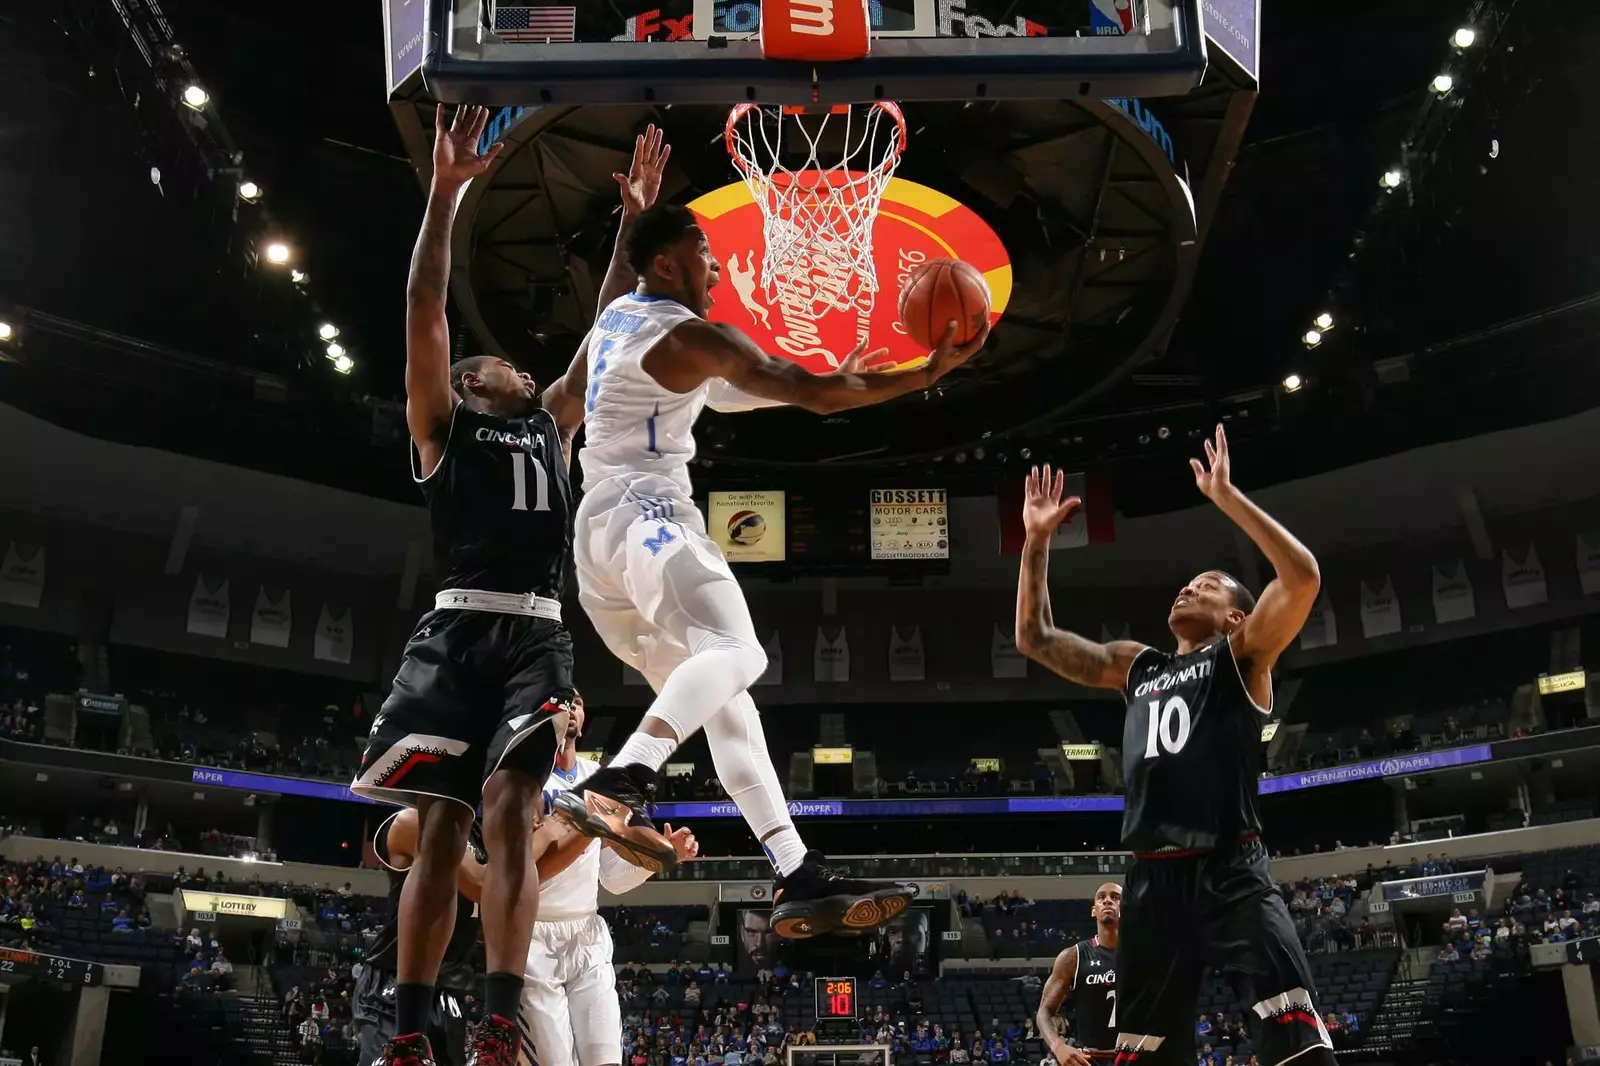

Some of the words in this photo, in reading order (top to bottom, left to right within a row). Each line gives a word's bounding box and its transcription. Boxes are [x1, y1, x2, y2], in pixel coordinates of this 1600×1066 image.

[510, 452, 551, 511] 11
[872, 490, 945, 503] GOSSETT
[875, 507, 911, 515] MOTOR
[915, 507, 943, 515] CARS
[1144, 695, 1191, 759] 10
[193, 770, 223, 782] PAPER
[1300, 765, 1379, 785] INTERNATIONAL
[1400, 757, 1431, 769] PAPER
[803, 804, 831, 812] PAPER
[220, 901, 257, 911] LOTTERY
[1, 961, 14, 971] 22
[57, 968, 65, 978] 2
[84, 973, 91, 982] 9
[827, 982, 852, 994] 2:06
[831, 994, 849, 1014] 10
